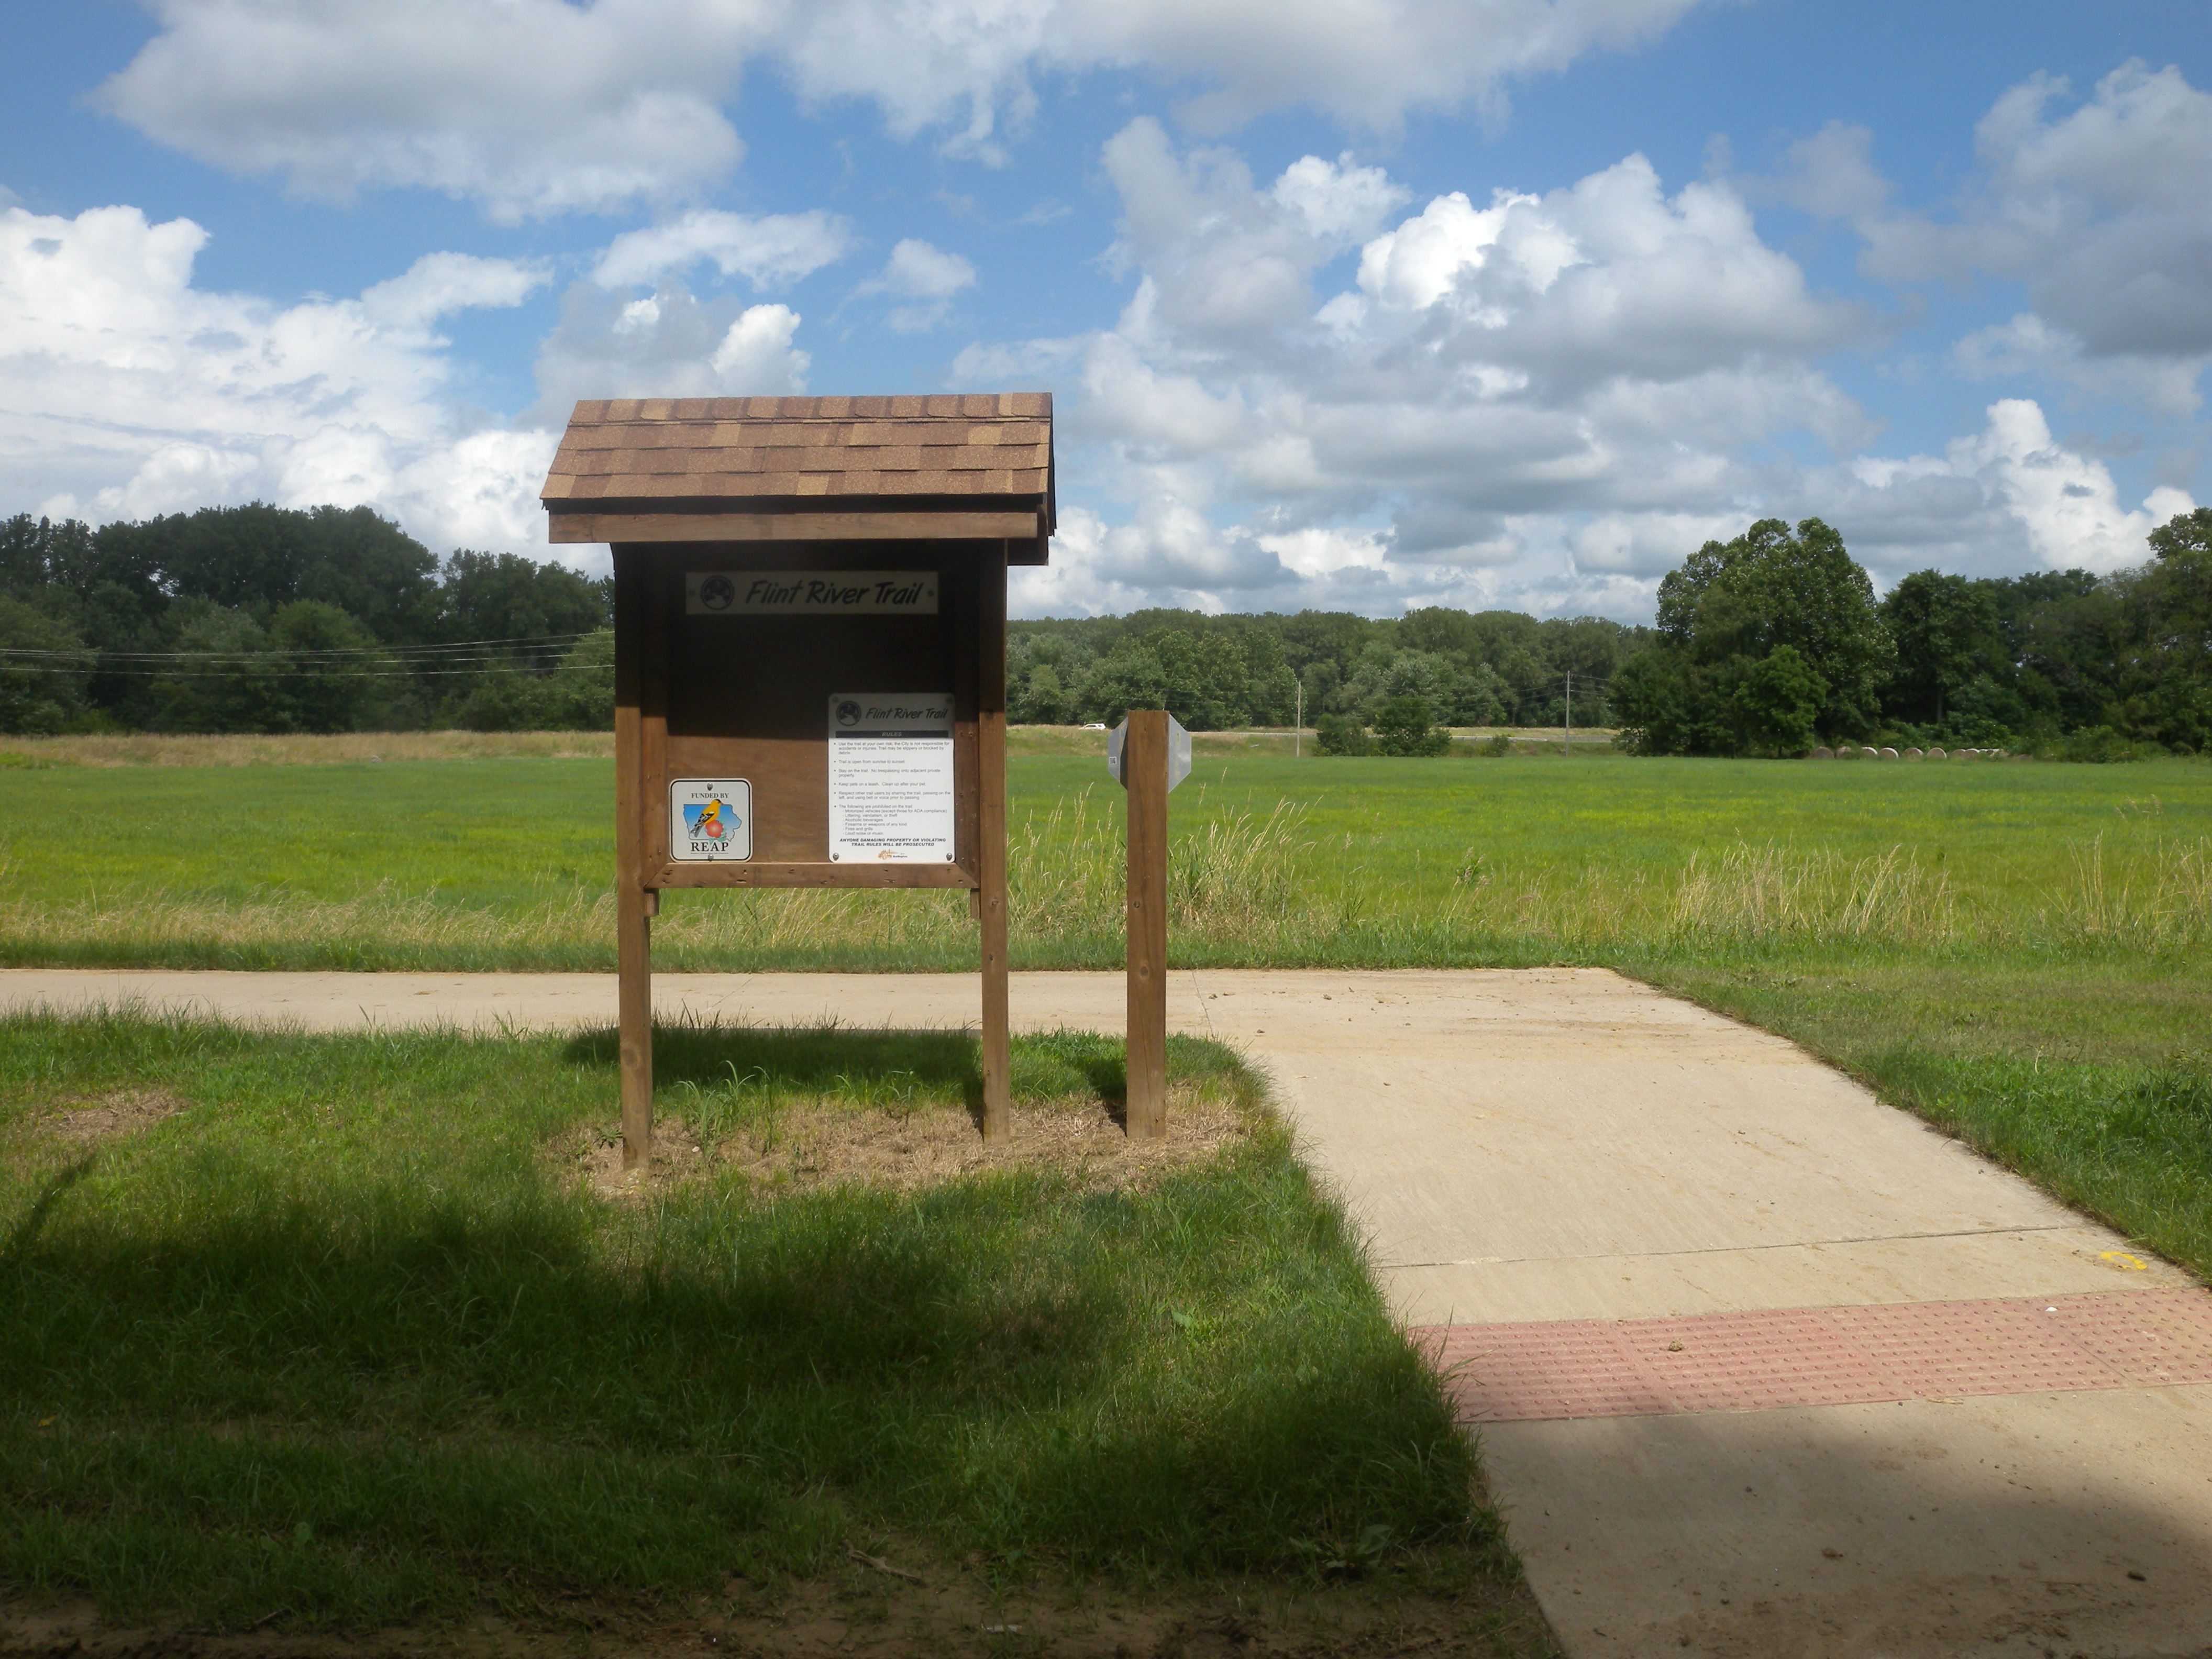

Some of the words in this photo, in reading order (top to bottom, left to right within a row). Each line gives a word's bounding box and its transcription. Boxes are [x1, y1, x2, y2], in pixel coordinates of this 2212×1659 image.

[746, 580, 803, 604] Flint
[806, 581, 869, 604] River
[875, 582, 923, 604] Trail
[866, 707, 893, 719] Flint
[894, 708, 923, 719] River
[925, 709, 948, 719] Trail
[691, 842, 729, 851] REAP
